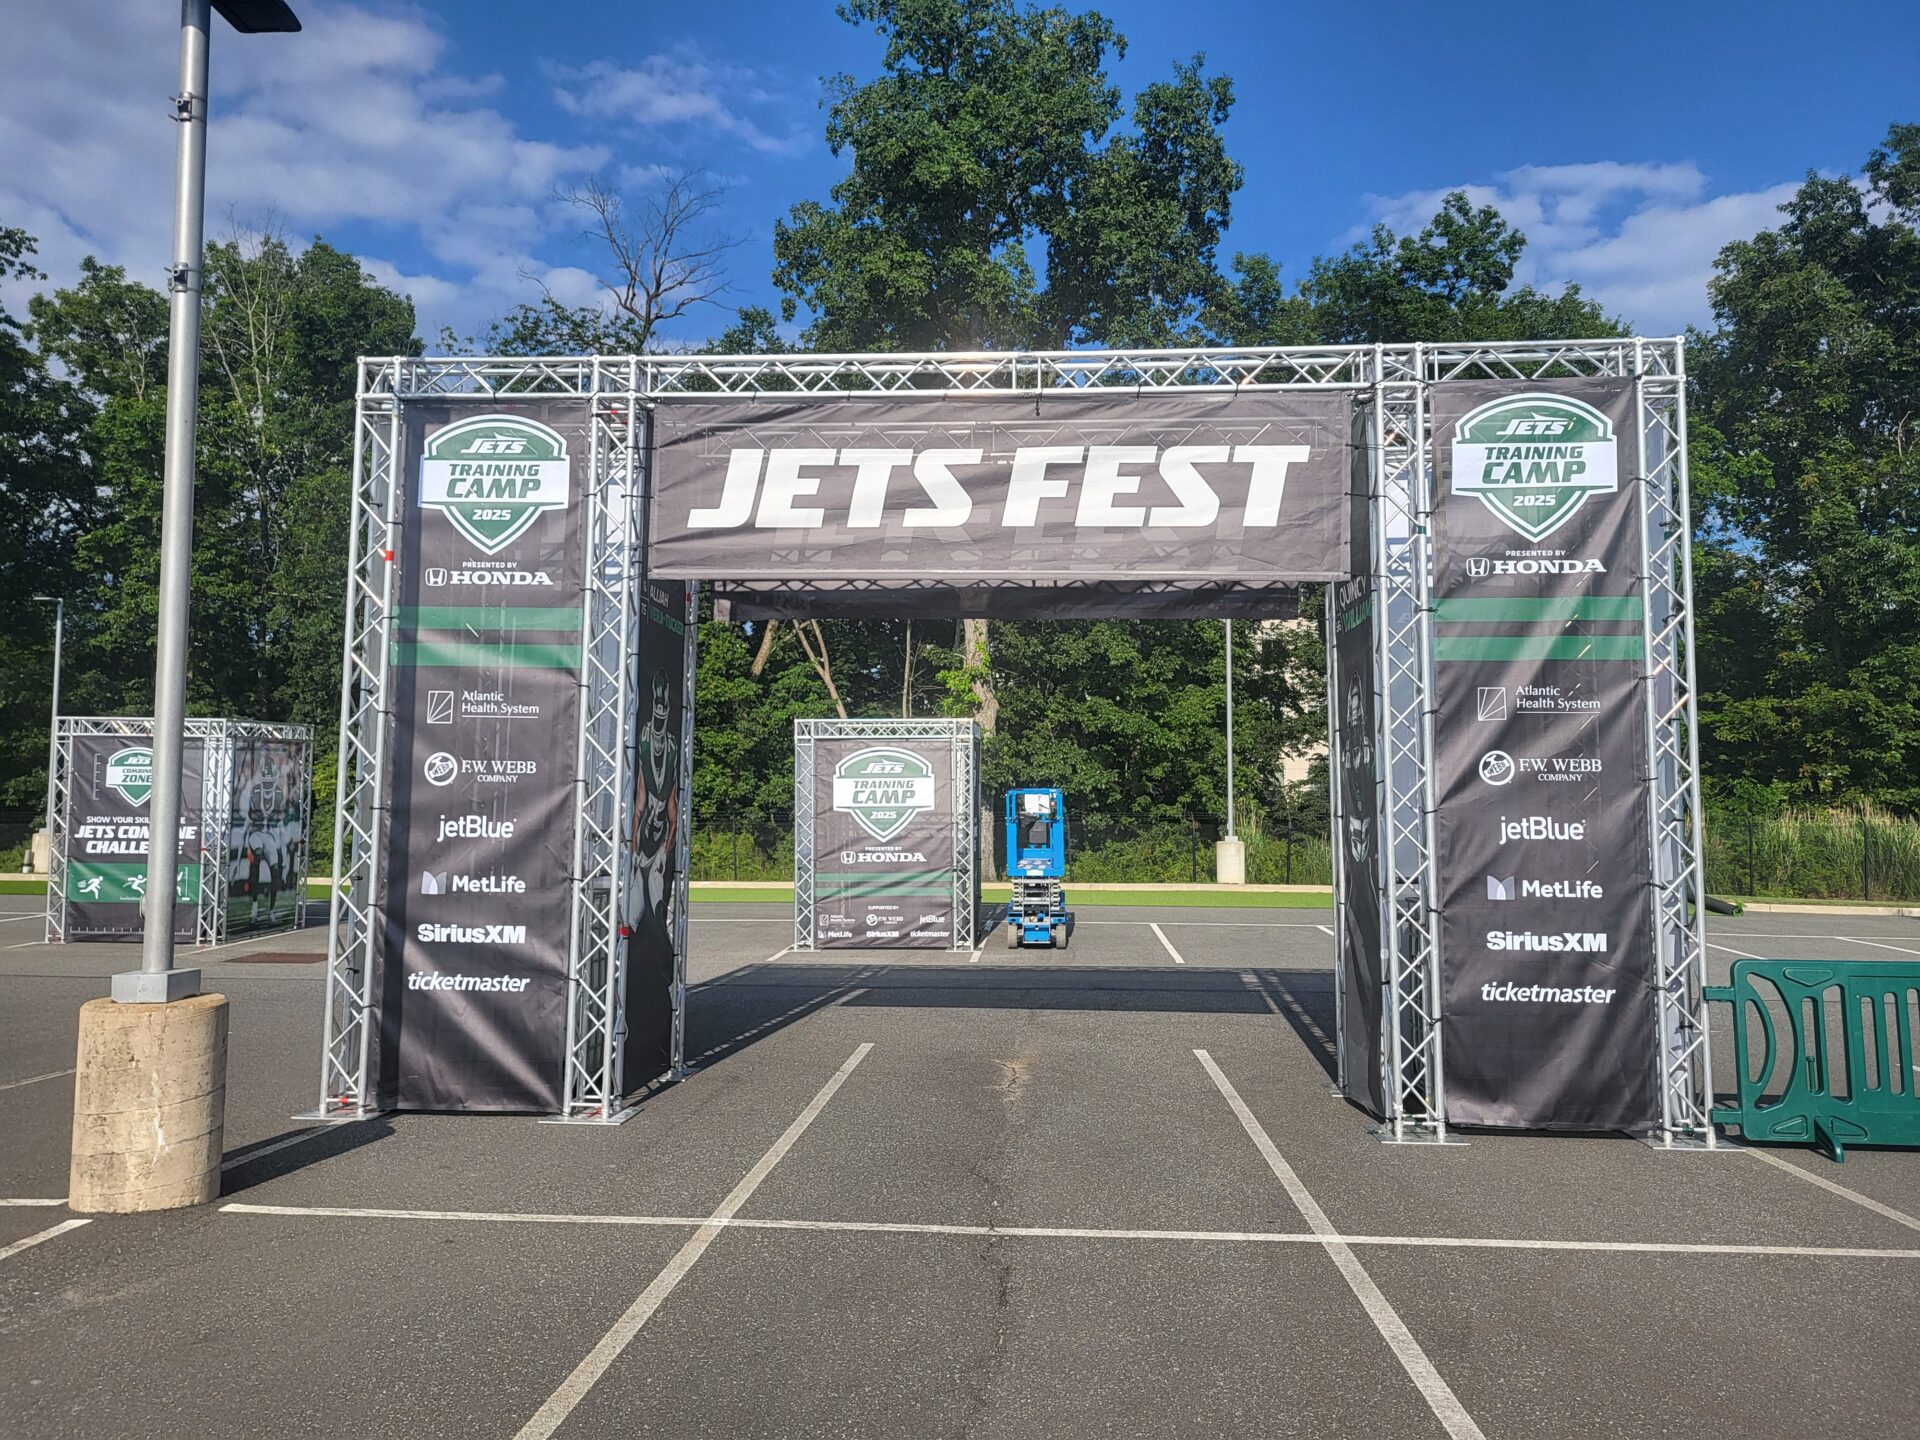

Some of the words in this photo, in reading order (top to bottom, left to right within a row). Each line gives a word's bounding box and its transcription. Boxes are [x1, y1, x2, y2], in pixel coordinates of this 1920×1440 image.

[1496, 414, 1569, 435] JETS
[460, 434, 528, 454] JETS
[1485, 446, 1584, 460] TRAINING
[449, 464, 540, 476] TRAINING
[1482, 461, 1586, 484] CAMP
[446, 478, 541, 498] CAMP
[687, 448, 984, 527] JETS
[1001, 445, 1311, 527] FEST
[1513, 495, 1556, 507] 2025
[472, 509, 511, 520] 2025
[462, 561, 506, 569] PRESENTED
[1493, 558, 1608, 574] HONDA
[450, 571, 554, 585] HONDA
[1339, 575, 1367, 611] QUINCY
[461, 690, 504, 701] Atlantic
[1515, 685, 1561, 696] Atlantic
[461, 703, 498, 713] Health
[500, 703, 540, 716] System
[1516, 698, 1555, 708] Health
[1557, 698, 1600, 711] System
[461, 760, 487, 773] F.W.
[491, 760, 537, 774] WEBB
[860, 761, 905, 774] JETS
[1518, 758, 1548, 772] F.W.
[1552, 758, 1602, 772] WEBB
[477, 774, 519, 783] COMPANY
[853, 780, 915, 789] TRAINING
[1537, 773, 1583, 782] COMPANY
[852, 790, 916, 804] CAMP
[870, 811, 897, 819] 2025
[74, 825, 116, 838] JETS
[437, 815, 514, 842] jetBlue
[1499, 816, 1584, 845] jetBlue
[857, 852, 927, 862] HONDA
[452, 875, 526, 893] MetLife
[1522, 880, 1604, 898] MetLife
[919, 914, 946, 925] jetBlue
[418, 924, 526, 944] SiriusXM
[1486, 931, 1608, 952] SiriusXM
[408, 971, 530, 992] ticketmaster
[1481, 981, 1616, 1004] ticketmaster
